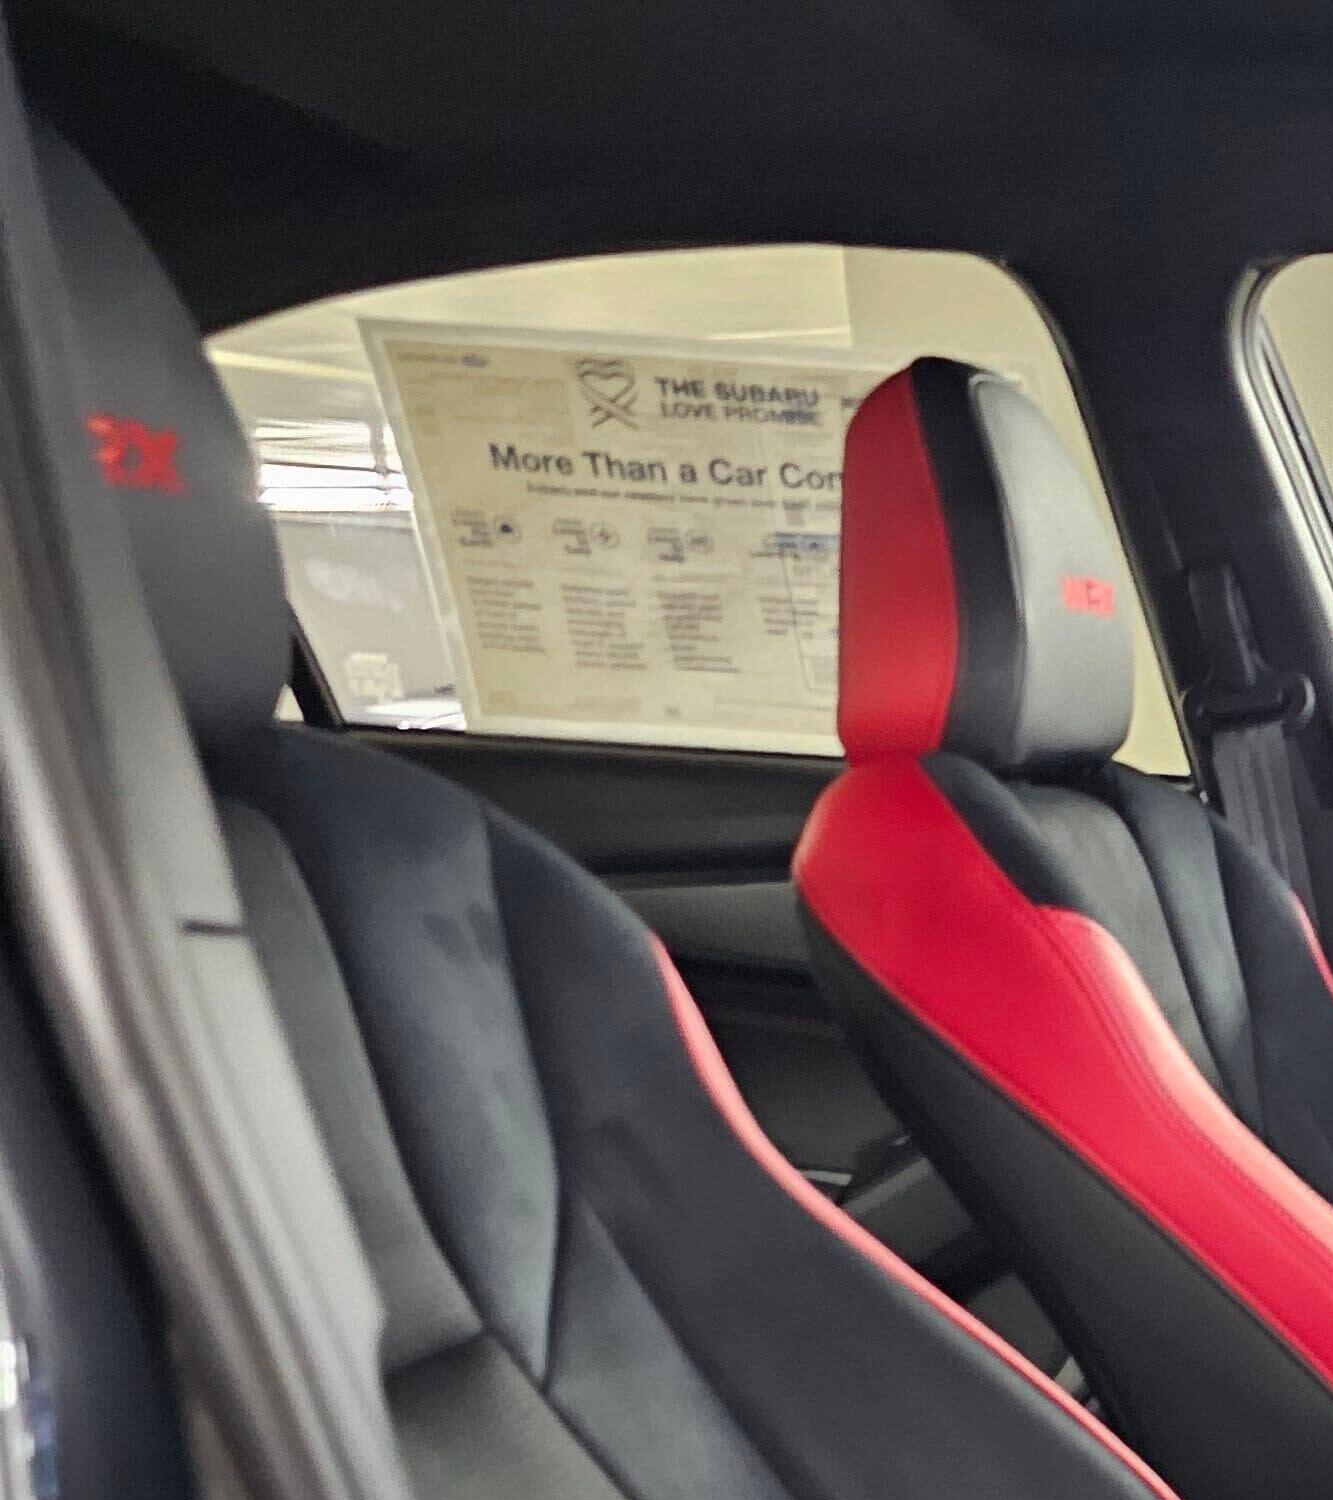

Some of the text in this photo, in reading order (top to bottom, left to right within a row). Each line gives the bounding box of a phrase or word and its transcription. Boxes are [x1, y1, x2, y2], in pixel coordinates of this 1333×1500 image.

[654, 376, 704, 397] THE
[713, 381, 819, 407] SUBARU
[488, 442, 575, 476] More
[581, 450, 668, 484] Than
[678, 463, 699, 484] a
[708, 457, 768, 486] Car
